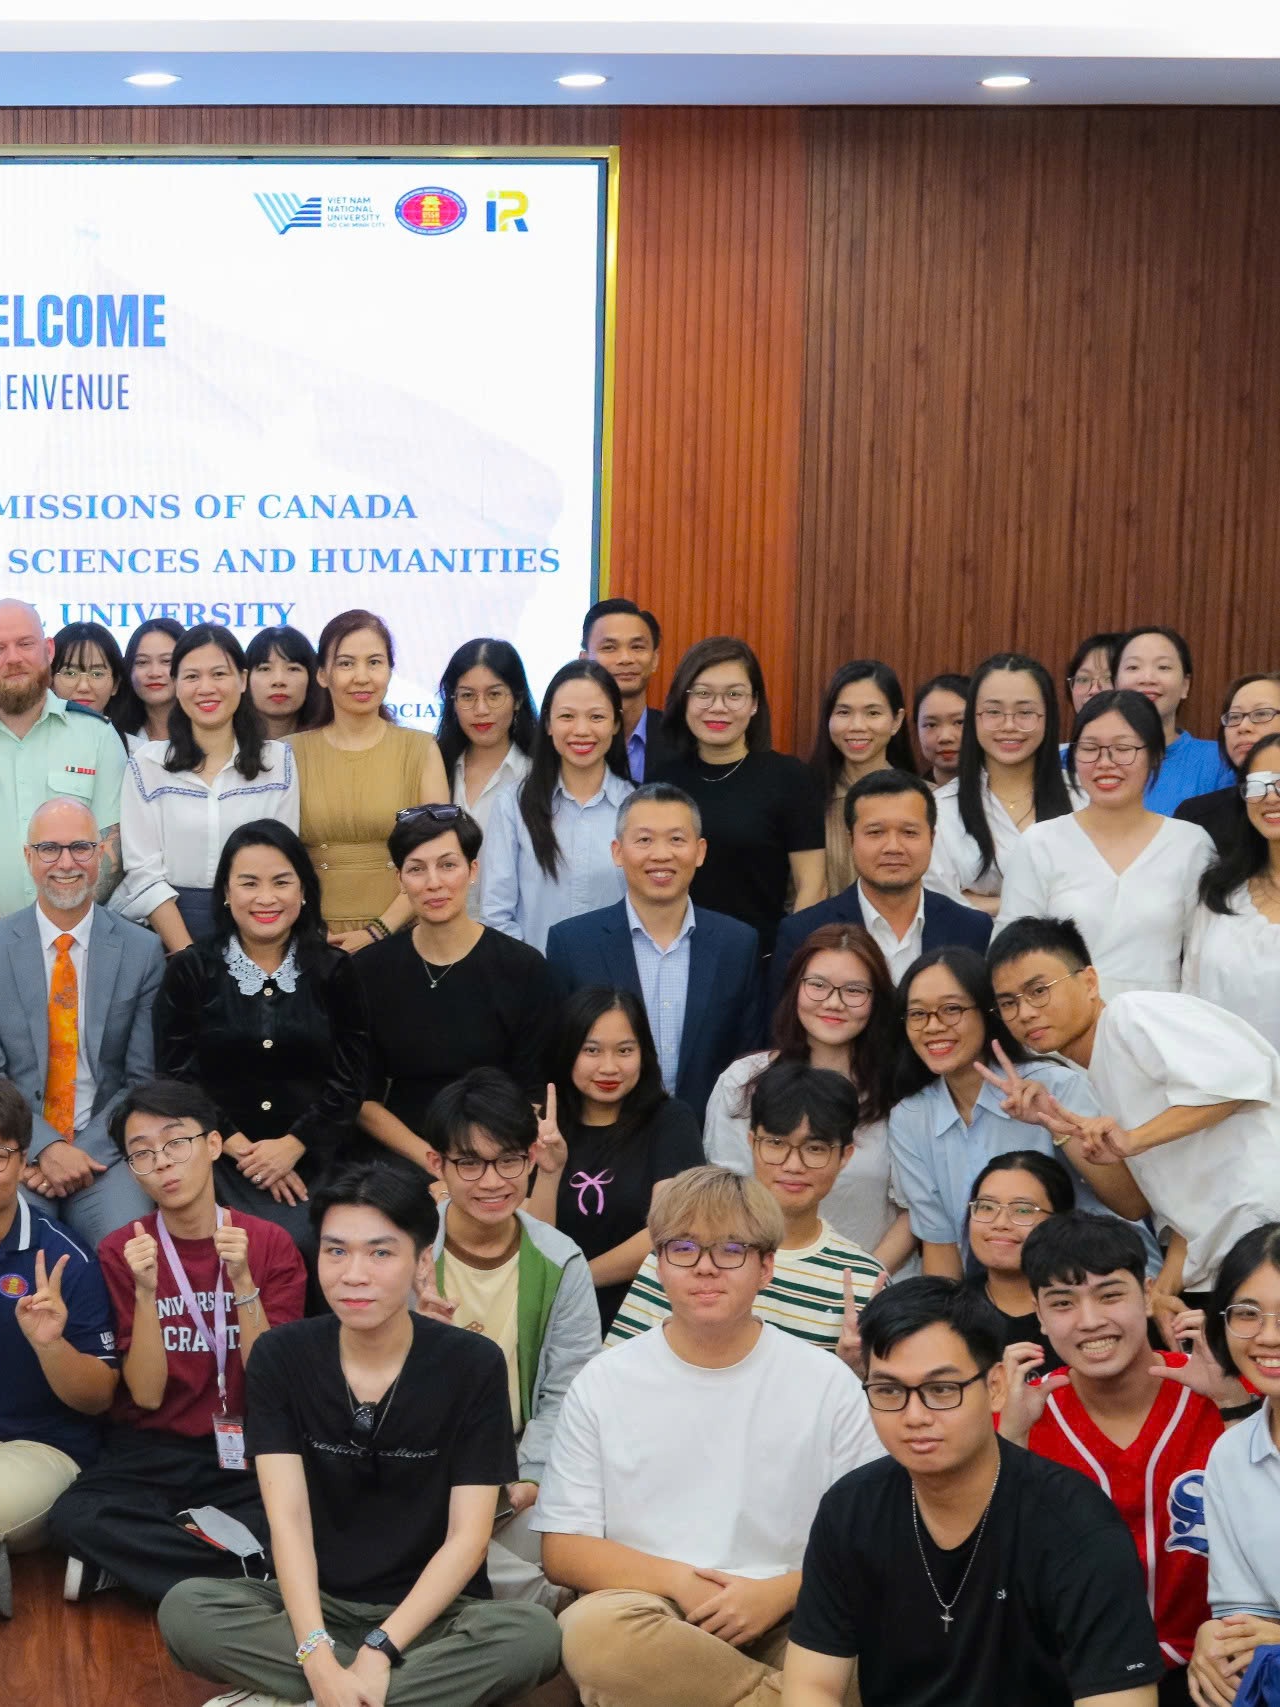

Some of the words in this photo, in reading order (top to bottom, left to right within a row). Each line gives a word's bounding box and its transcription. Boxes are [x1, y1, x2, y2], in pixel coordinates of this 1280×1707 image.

[327, 205, 373, 213] NATIONAL
[327, 214, 380, 222] UNIVERSITY
[194, 494, 246, 520] OF
[257, 494, 418, 520] CANADA
[8, 548, 200, 574] SCIENCES
[213, 548, 297, 574] AND
[310, 547, 561, 574] HUMANITIES
[61, 601, 297, 628] UNIVERSITY
